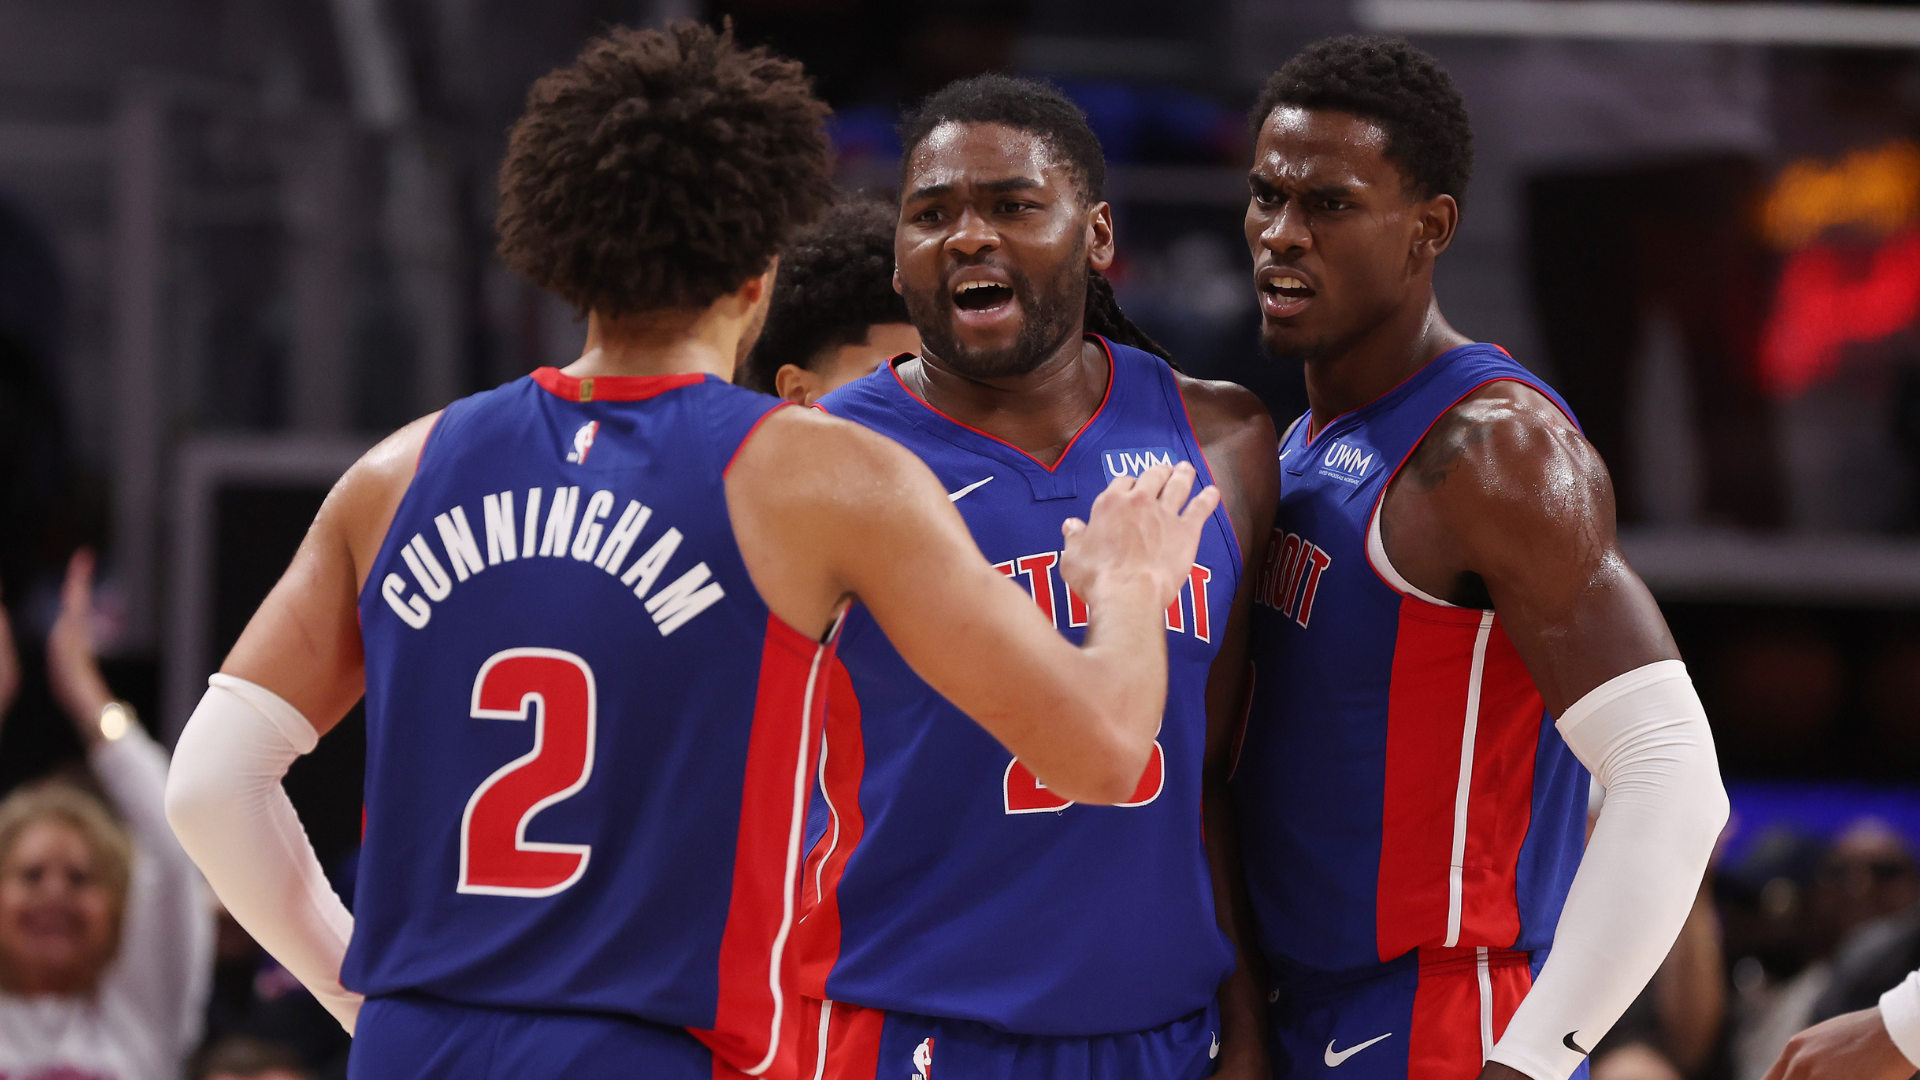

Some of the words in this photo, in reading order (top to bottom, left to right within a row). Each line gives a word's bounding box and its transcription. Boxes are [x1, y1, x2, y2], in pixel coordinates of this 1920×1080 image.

[1105, 451, 1173, 477] UWM
[1324, 442, 1374, 477] UWM
[381, 485, 726, 637] CUNNINGHAM
[1254, 527, 1332, 630] ROIT
[456, 647, 598, 898] 2
